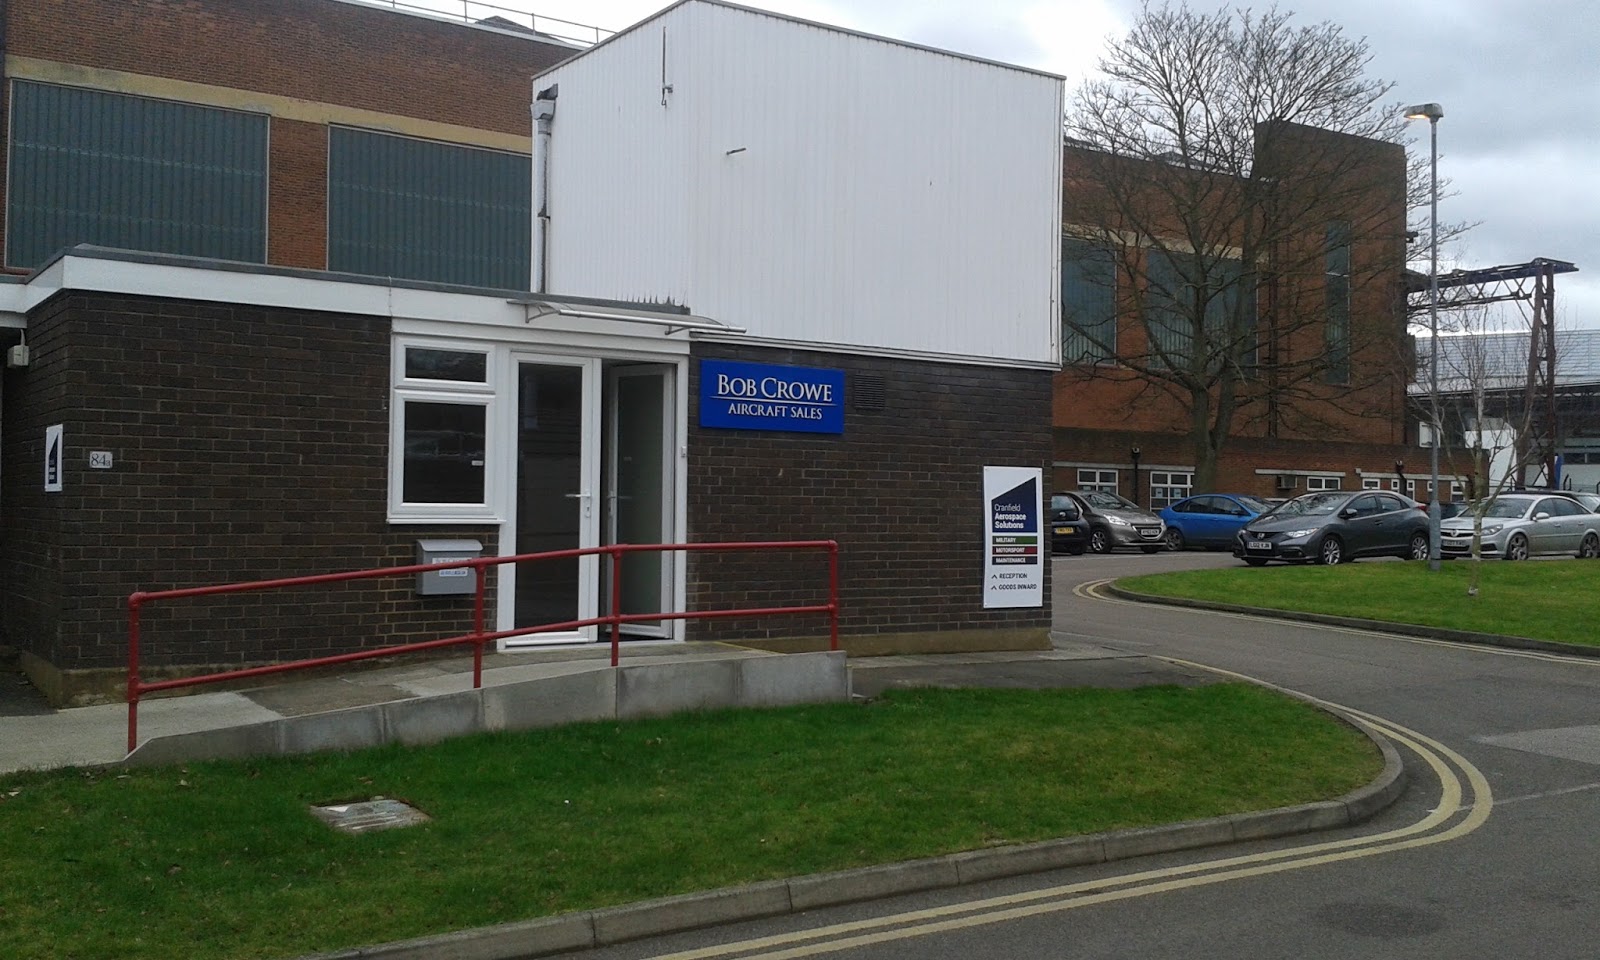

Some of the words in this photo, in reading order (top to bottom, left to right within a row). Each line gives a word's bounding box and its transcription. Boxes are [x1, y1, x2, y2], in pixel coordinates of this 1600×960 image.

[728, 403, 788, 417] AIRCRAFT
[790, 406, 823, 420] SALES
[994, 512, 1026, 521] Aerospace
[994, 521, 1024, 529] Solutions
